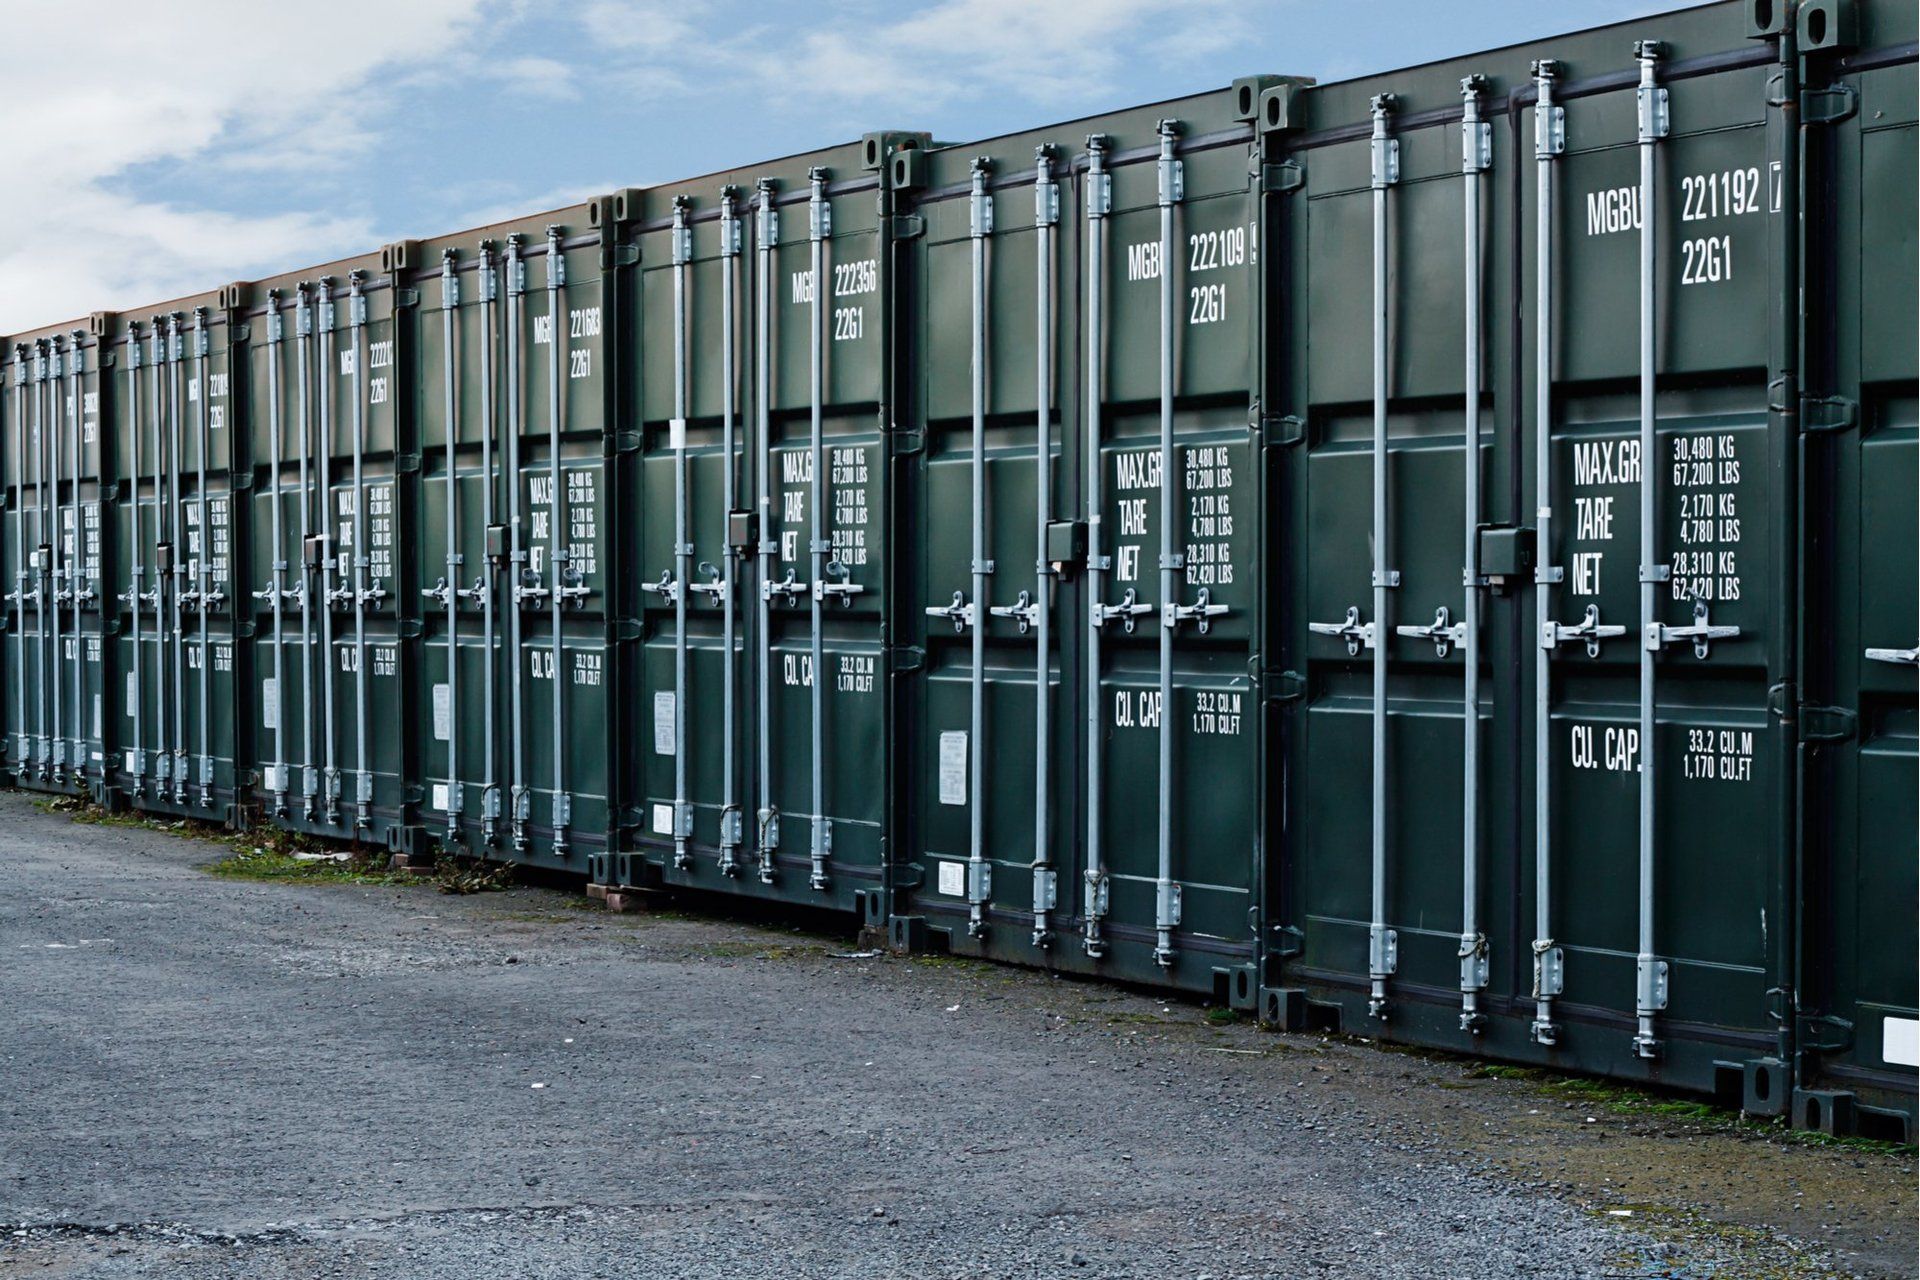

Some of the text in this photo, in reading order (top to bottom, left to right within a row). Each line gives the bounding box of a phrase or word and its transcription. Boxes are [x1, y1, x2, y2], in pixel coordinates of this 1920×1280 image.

[1587, 185, 1641, 235] MGBU
[1682, 167, 1759, 221] 221192
[1190, 227, 1244, 272] 222109
[1682, 235, 1731, 285] 22G1
[835, 259, 876, 296] 222356
[1190, 284, 1226, 324] 22G1
[835, 306, 863, 340] 22G1
[571, 349, 590, 378] 22G1
[1217, 447, 1228, 466] KG
[1673, 435, 1734, 461] 30,480 KG
[1574, 440, 1641, 485] MAX.GR
[1673, 461, 1740, 487] 67,200 LBS
[1217, 468, 1232, 488] LBS
[784, 491, 804, 522] TARE
[1118, 499, 1147, 535] TARE
[1192, 495, 1229, 516] 2,170 KG
[1575, 497, 1613, 540] TARE
[1681, 494, 1735, 518] 2,170 KG
[1218, 516, 1233, 536] LBS
[1680, 519, 1740, 544] 4,780 LBS
[782, 531, 798, 562] NET
[1186, 543, 1229, 564] 28,310 KG
[1117, 545, 1140, 581] NET
[1186, 564, 1233, 585] 62,420 LBS
[1572, 553, 1602, 595] NET
[1672, 551, 1735, 576] 28,310 KG
[1672, 577, 1740, 601] 62,420 LBS
[1115, 691, 1134, 727] CU.
[1197, 692, 1240, 713] 33.2 CU.M
[1193, 713, 1215, 734] 1,170
[1571, 725, 1641, 772] CU. CAP.
[1689, 729, 1753, 755] 33.2 CU.M
[1684, 755, 1752, 781] 1,170 CU.FT
